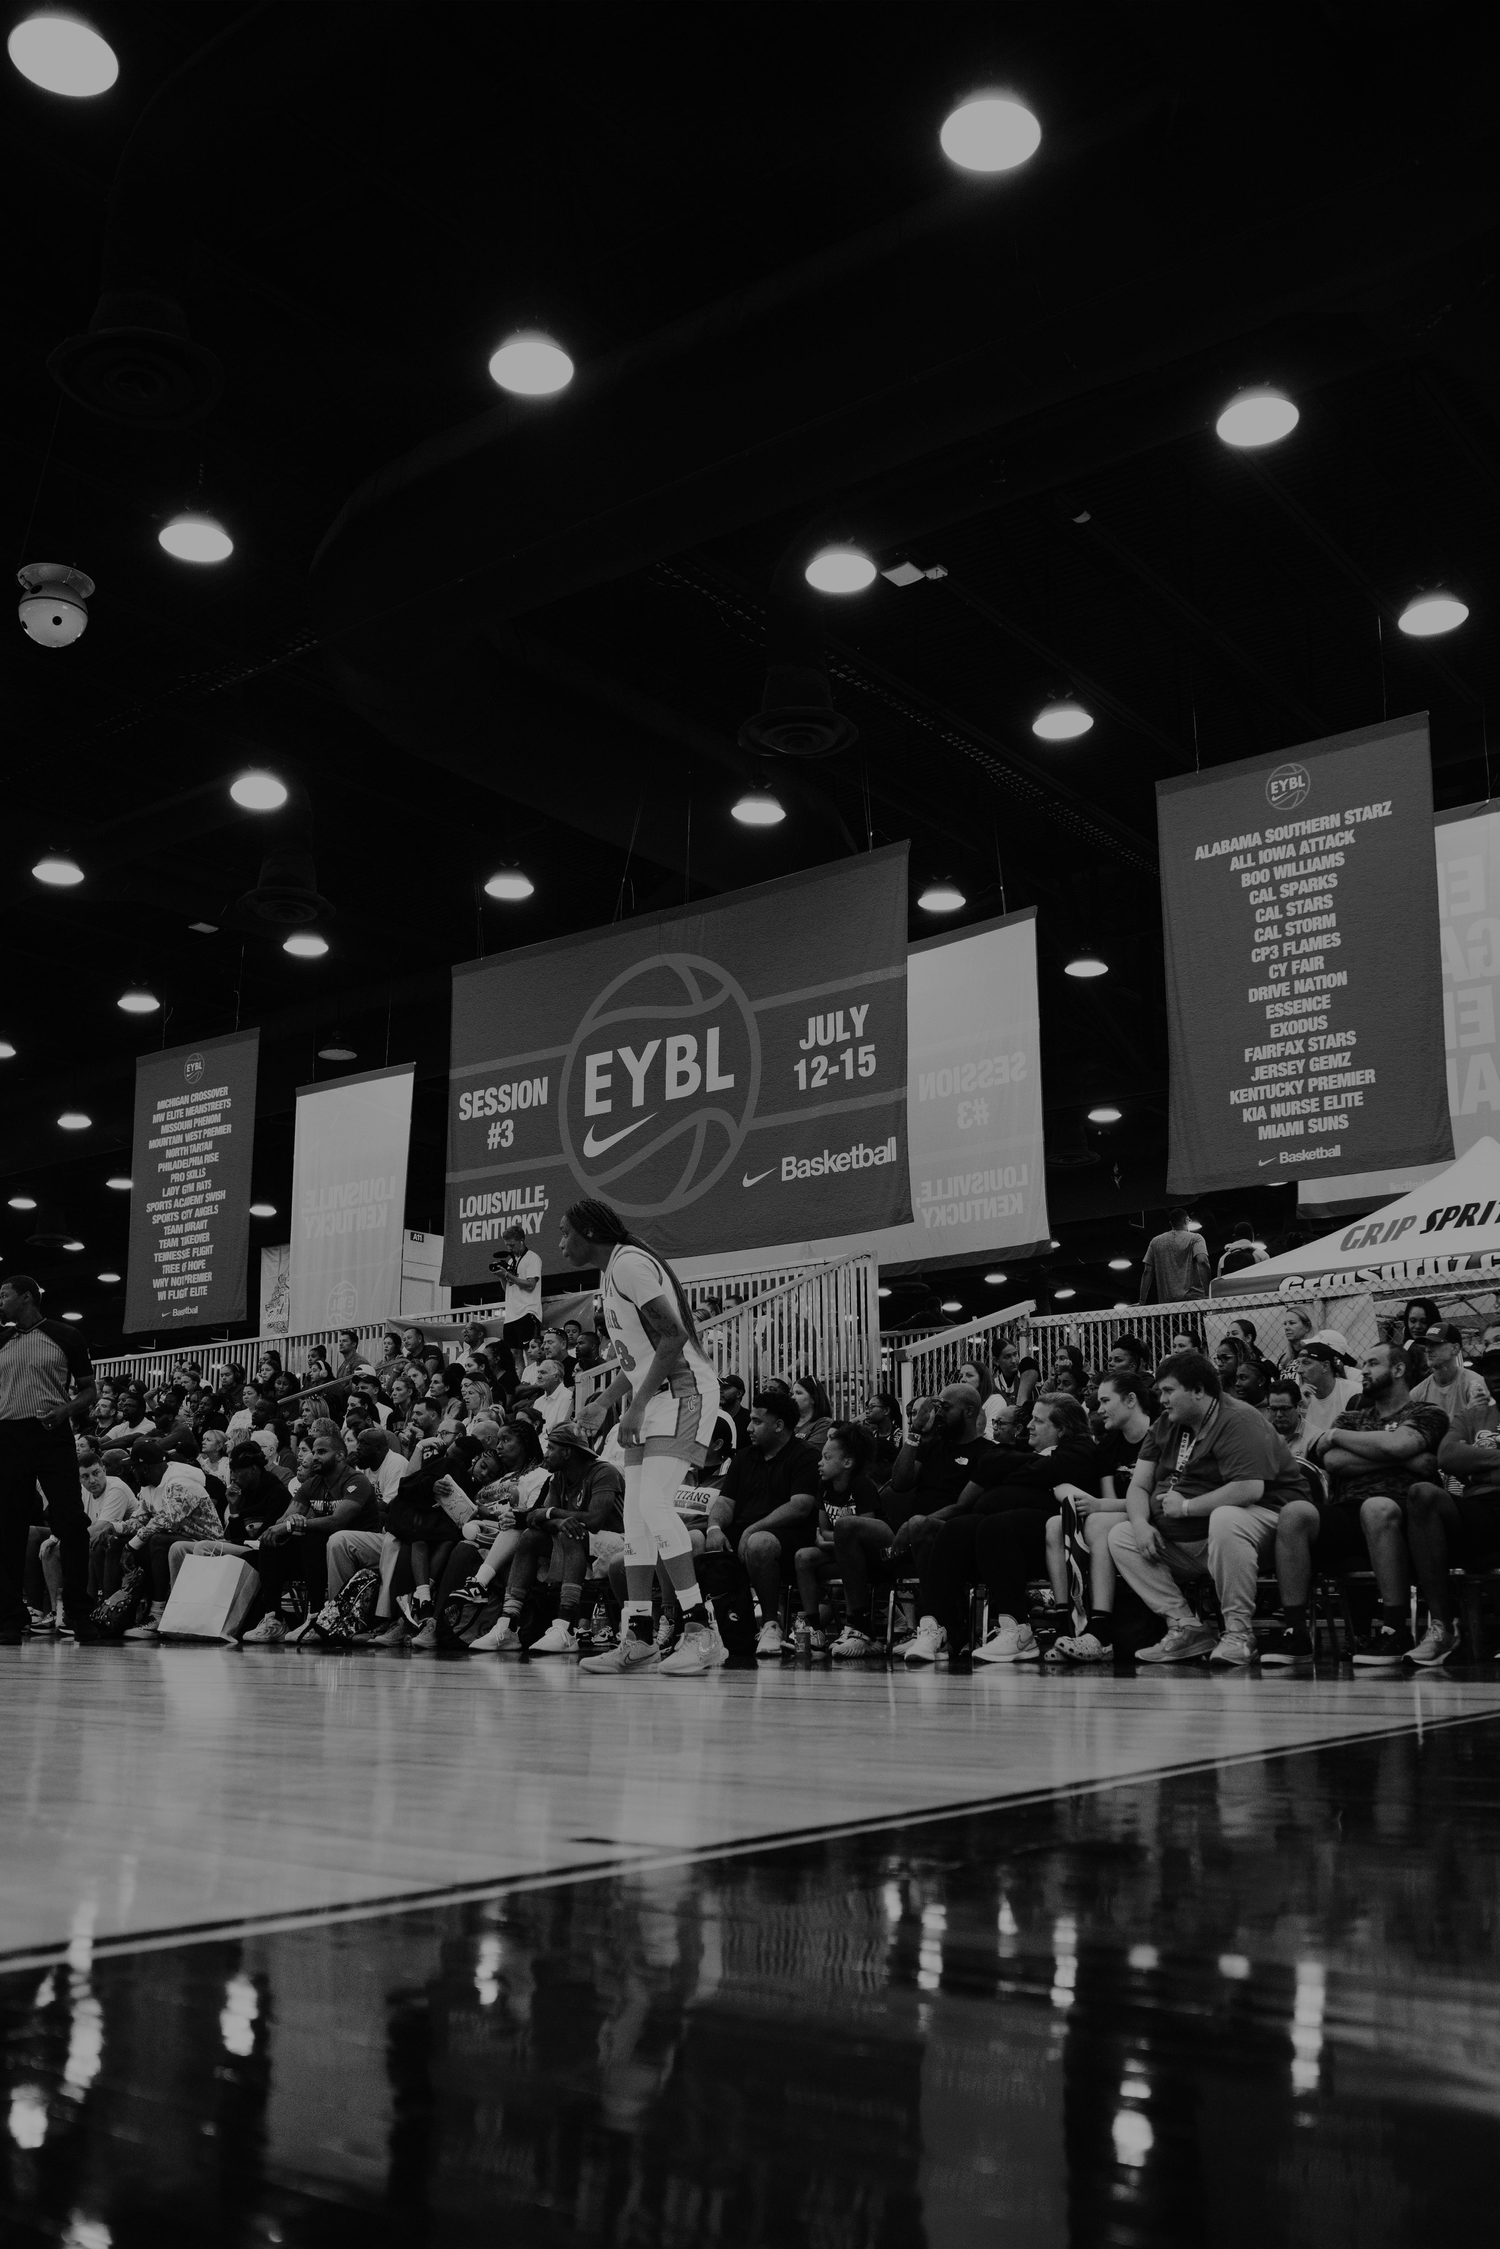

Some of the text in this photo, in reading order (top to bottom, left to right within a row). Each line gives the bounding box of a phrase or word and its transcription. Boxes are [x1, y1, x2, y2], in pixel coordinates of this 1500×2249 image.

[1271, 775, 1305, 794] EYBL
[1195, 801, 1392, 860] ALABAMA SOUTHERN STARZ
[1230, 829, 1356, 871] ALL IOWA ATTACK
[1241, 851, 1345, 888] BOO WILLIAMS
[1249, 873, 1338, 905] CAL SPARKS
[1256, 894, 1333, 923] CAL STARS
[1254, 913, 1336, 942] CAL STORM
[1251, 932, 1342, 963] CP3 FLAMES
[1269, 955, 1324, 979] CY FAIR
[1248, 971, 1348, 1003] DRIVE NATION
[1266, 994, 1331, 1019] ESSENCE
[799, 1004, 870, 1051] JULY
[1270, 1015, 1328, 1038] EXODUS
[1244, 1031, 1356, 1062] FAIRFAX STARS
[187, 1061, 202, 1072] EYBL
[584, 1026, 735, 1118] EYBL
[794, 1044, 876, 1091] 12-15
[1251, 1052, 1351, 1081] JERSEY GEMZ
[157, 1086, 228, 1110] MICHIGAN CROSSOVER
[459, 1077, 548, 1120] SESSION
[1230, 1069, 1376, 1104] KENTUCKY PREMIER
[152, 1098, 231, 1124] MW ELITE MEANSTREETS
[1242, 1091, 1364, 1122] KIA NURSE ELITE
[149, 1124, 232, 1149] MOUNTAIN WEST PREMIER
[160, 1113, 221, 1134] MISSOURI PHENOM
[487, 1119, 514, 1150] #3
[1258, 1114, 1349, 1140] MIAMI SUNS
[166, 1140, 213, 1158] NORTH TARTAN
[781, 1137, 897, 1182] Basketball
[1279, 1145, 1341, 1163] Basketball
[158, 1152, 219, 1173] PHILADELPHIA RISE
[170, 1167, 206, 1183] PRO SKILLS
[146, 1200, 172, 1212] SPORTS
[205, 1190, 226, 1202] SWISH
[162, 1186, 180, 1197] LADY
[196, 1179, 212, 1191] RATS
[152, 1212, 179, 1224] SPORTS
[194, 1204, 218, 1218] ANGELS
[459, 1185, 549, 1219] LOUISVILLE,
[164, 1224, 183, 1235] TEAM
[1340, 1215, 1417, 1251] GRIP
[159, 1238, 178, 1249] TEAM
[192, 1245, 214, 1257] FLIGHT
[162, 1263, 180, 1274] TREE
[188, 1259, 206, 1270] HOPE
[153, 1277, 169, 1288] WHY
[158, 1286, 208, 1301] WI FLIGT ELITE
